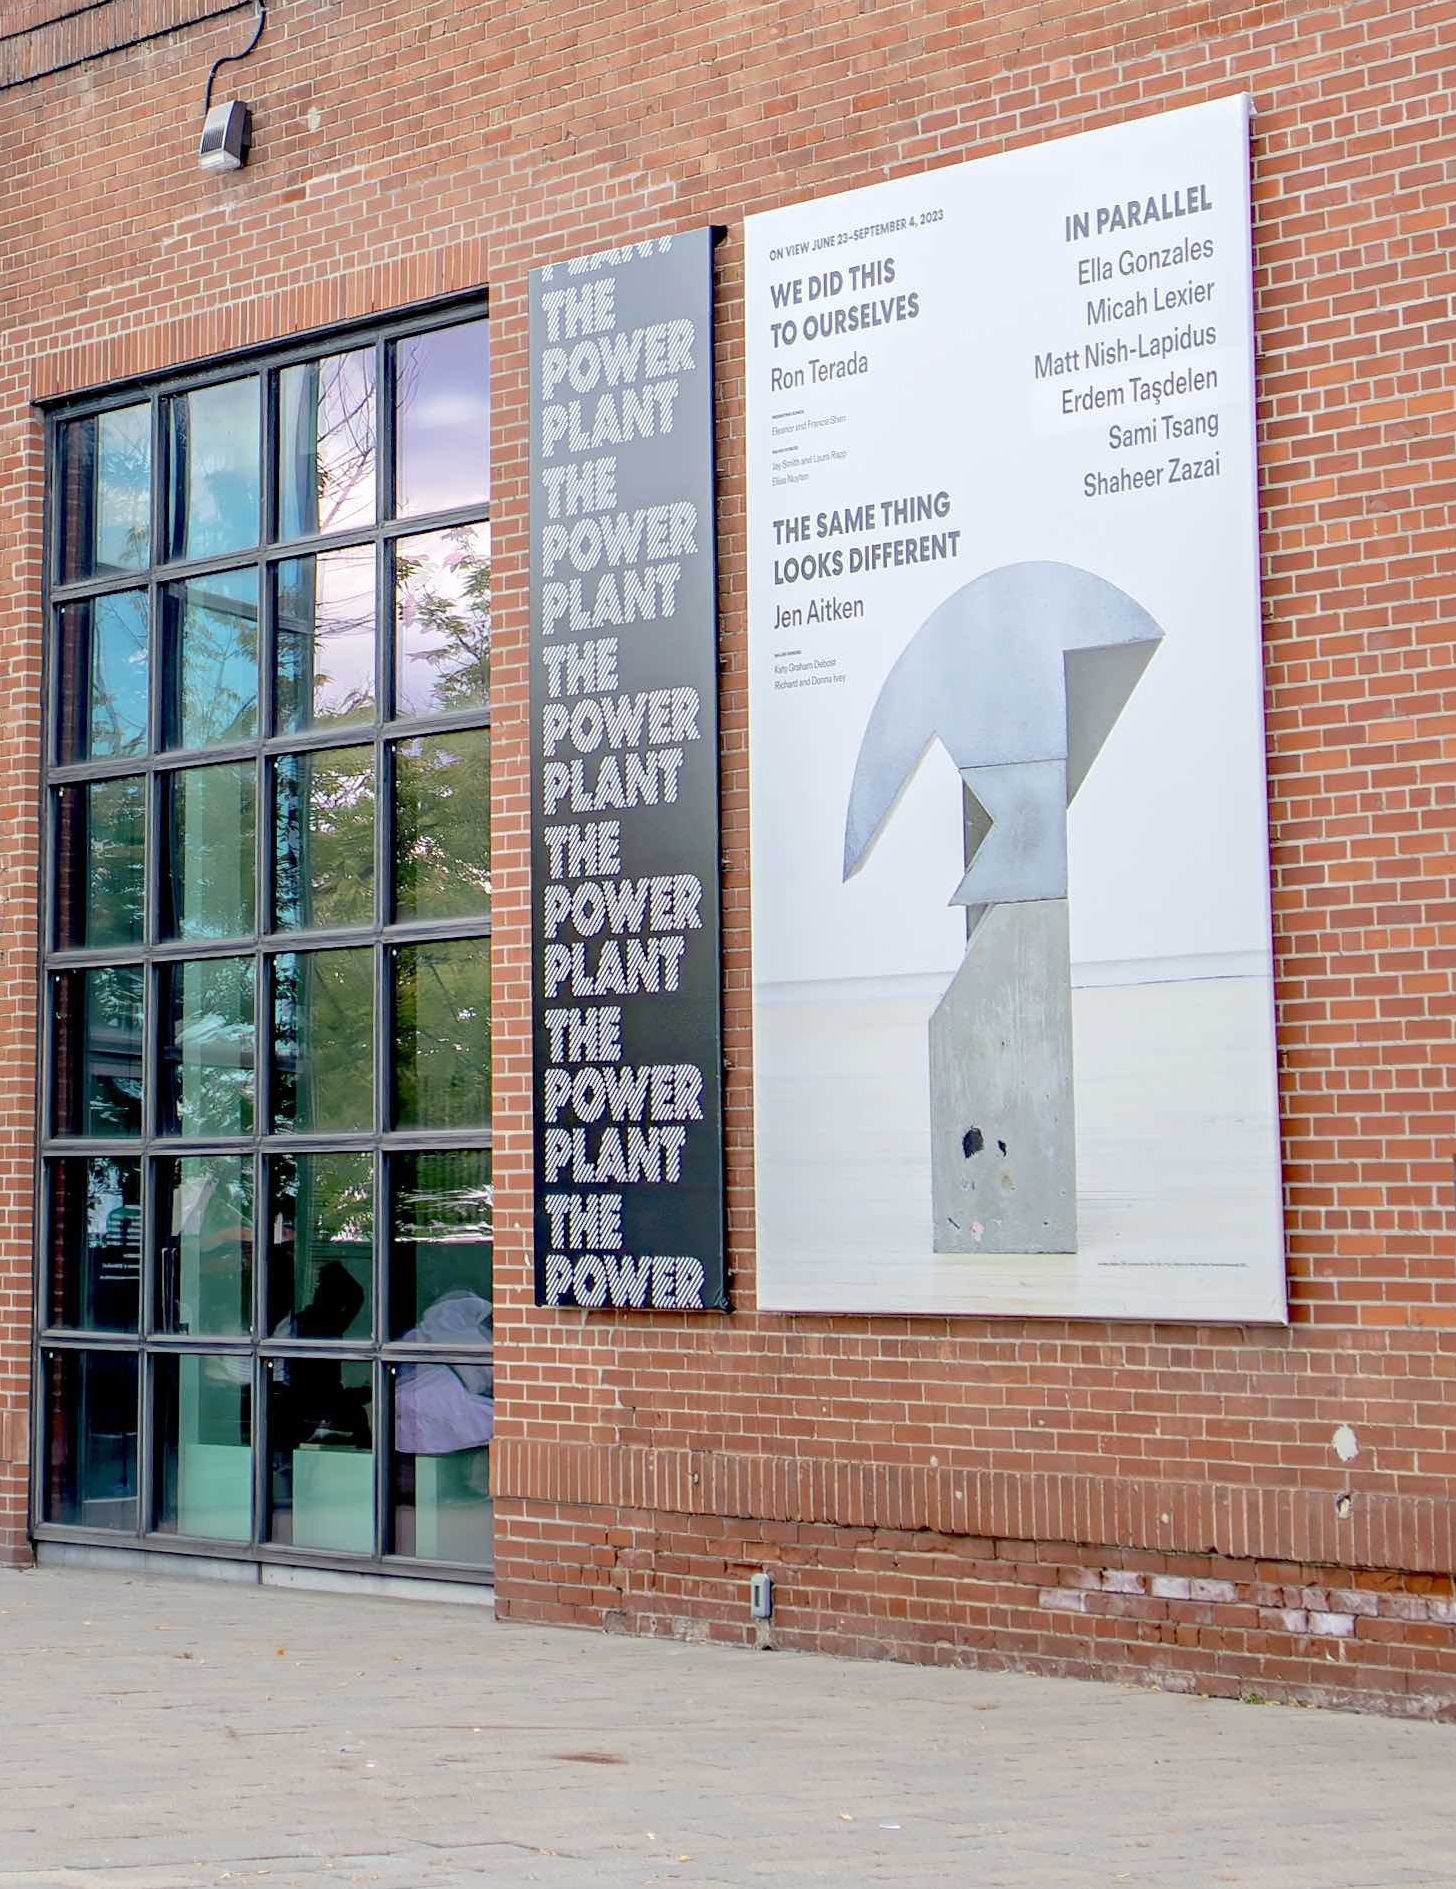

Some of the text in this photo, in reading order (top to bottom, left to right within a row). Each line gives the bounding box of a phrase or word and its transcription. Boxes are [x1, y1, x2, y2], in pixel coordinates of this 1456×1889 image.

[769, 248, 783, 261] ON
[786, 241, 809, 257] VIEW
[812, 236, 835, 251] JUNE
[920, 209, 944, 225] 2023
[1066, 184, 1212, 242] IN PARALLEL
[770, 257, 896, 309] WE DID THIS
[1078, 237, 1214, 285] Ella Gonzales
[542, 277, 616, 342] THE
[771, 292, 920, 348] TO OURSELVES
[1087, 280, 1215, 325] Micah Lexier
[542, 318, 696, 400] POWER
[771, 351, 868, 392] Ron Terada
[1035, 324, 1217, 379] Matt Nish-Lapidus
[542, 379, 679, 457] PLANT
[1062, 367, 1218, 415] Erdem Taşdelen
[1109, 413, 1219, 449] Sami Tsang
[542, 456, 617, 519] THE
[1084, 451, 1220, 497] Shaheer Zazai
[542, 501, 698, 577] POWER
[773, 491, 950, 545] THE SAME THING
[774, 530, 961, 585] LOOKS DIFFERENT
[543, 562, 681, 635] PLANT
[774, 597, 864, 629] Jen Aitken
[543, 637, 618, 698] THE
[543, 687, 701, 756] POWER
[543, 748, 683, 815] PLANT
[544, 821, 621, 879] THE
[544, 874, 703, 938] POWER
[544, 936, 685, 998] PLANT
[545, 1006, 622, 1063] THE
[544, 1064, 704, 1122] POWER
[545, 1126, 686, 1183] PLANT
[545, 1194, 622, 1249] THE
[545, 1254, 704, 1309] POWER
